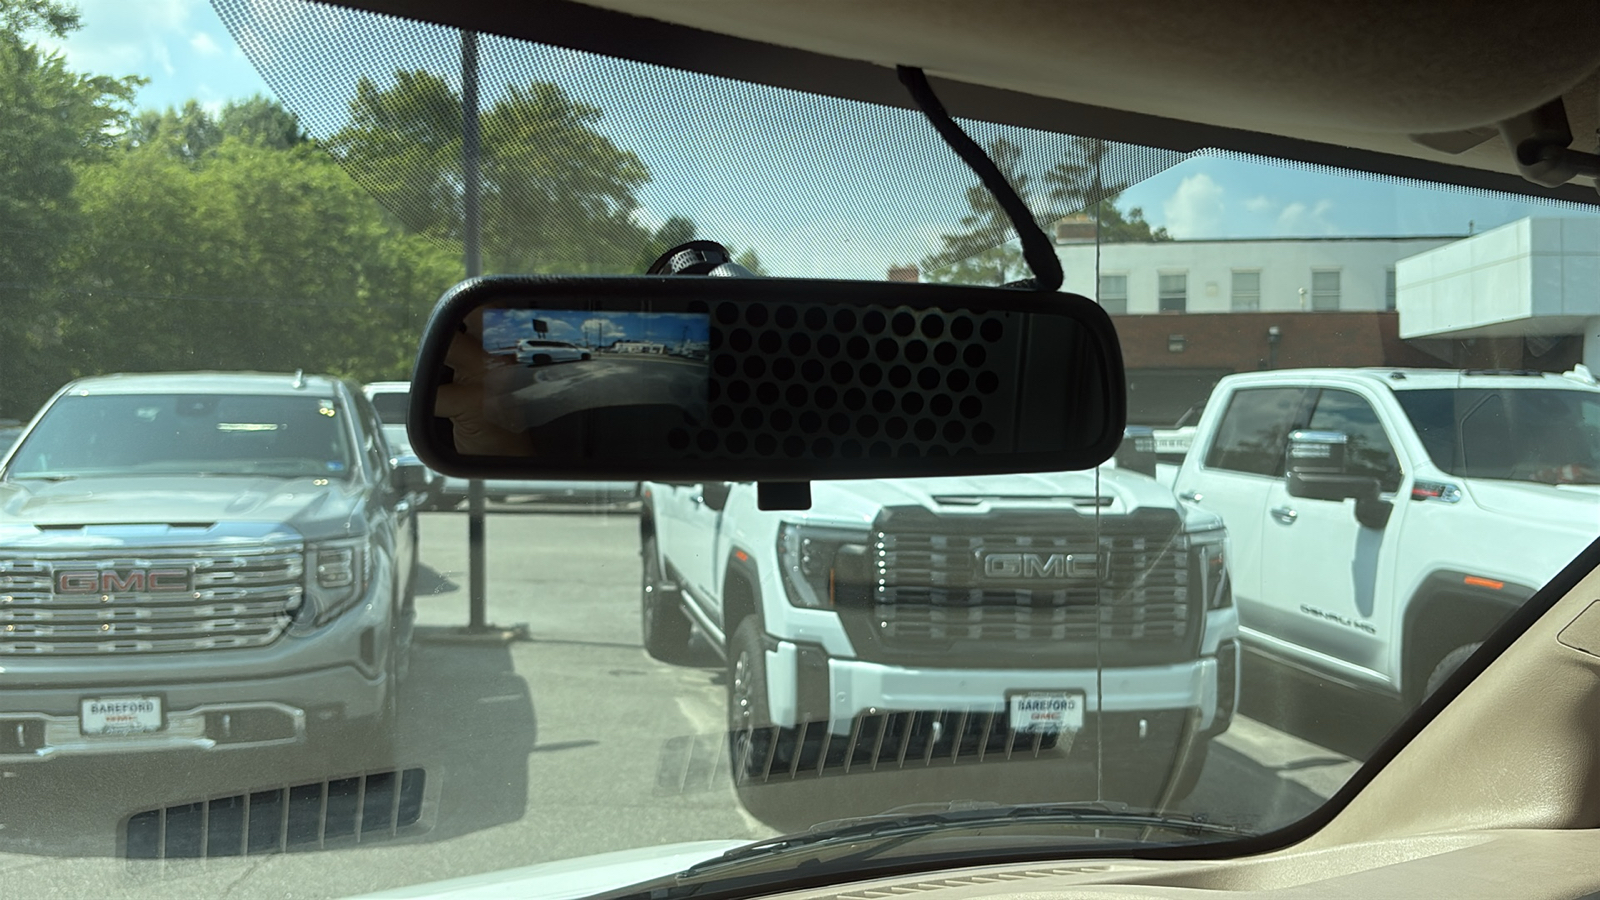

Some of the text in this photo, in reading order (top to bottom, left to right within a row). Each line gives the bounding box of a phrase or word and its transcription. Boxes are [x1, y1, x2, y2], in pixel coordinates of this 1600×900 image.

[985, 553, 1099, 577] GMC
[60, 569, 187, 592] GMC
[91, 702, 153, 714] BAREFORD
[1018, 700, 1075, 711] BAREFORD
